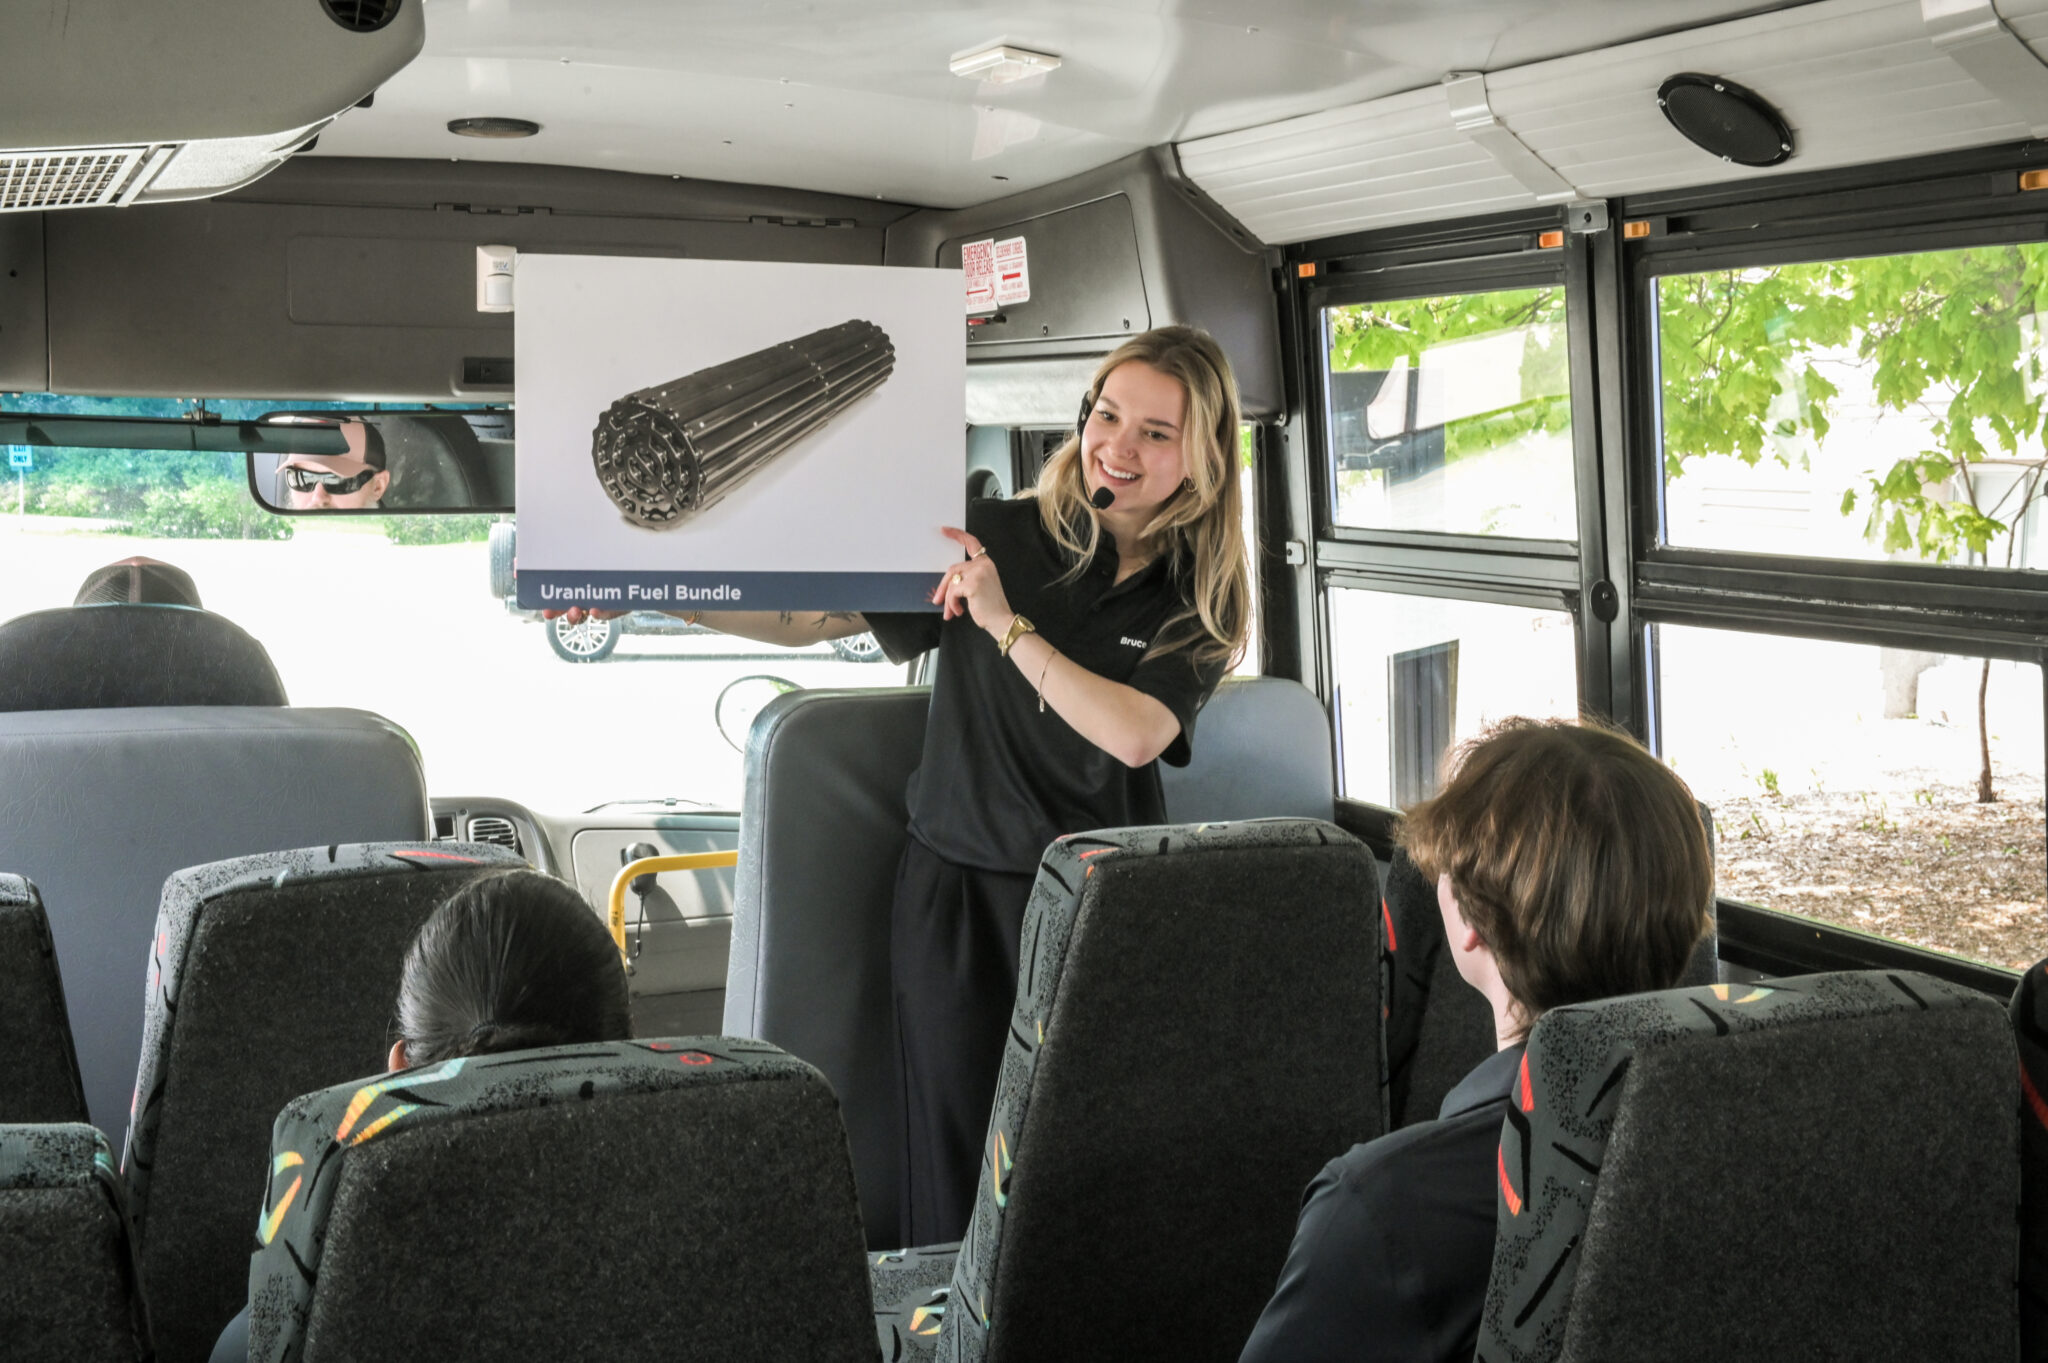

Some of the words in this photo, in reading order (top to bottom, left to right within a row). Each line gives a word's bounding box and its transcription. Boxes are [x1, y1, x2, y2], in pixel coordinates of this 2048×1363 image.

[964, 241, 993, 262] EMERGENCY
[976, 257, 994, 275] RELEASE
[540, 584, 622, 600] Uranium
[628, 584, 669, 600] Fuel
[675, 584, 742, 600] Bundle
[1120, 636, 1147, 649] Bruce
